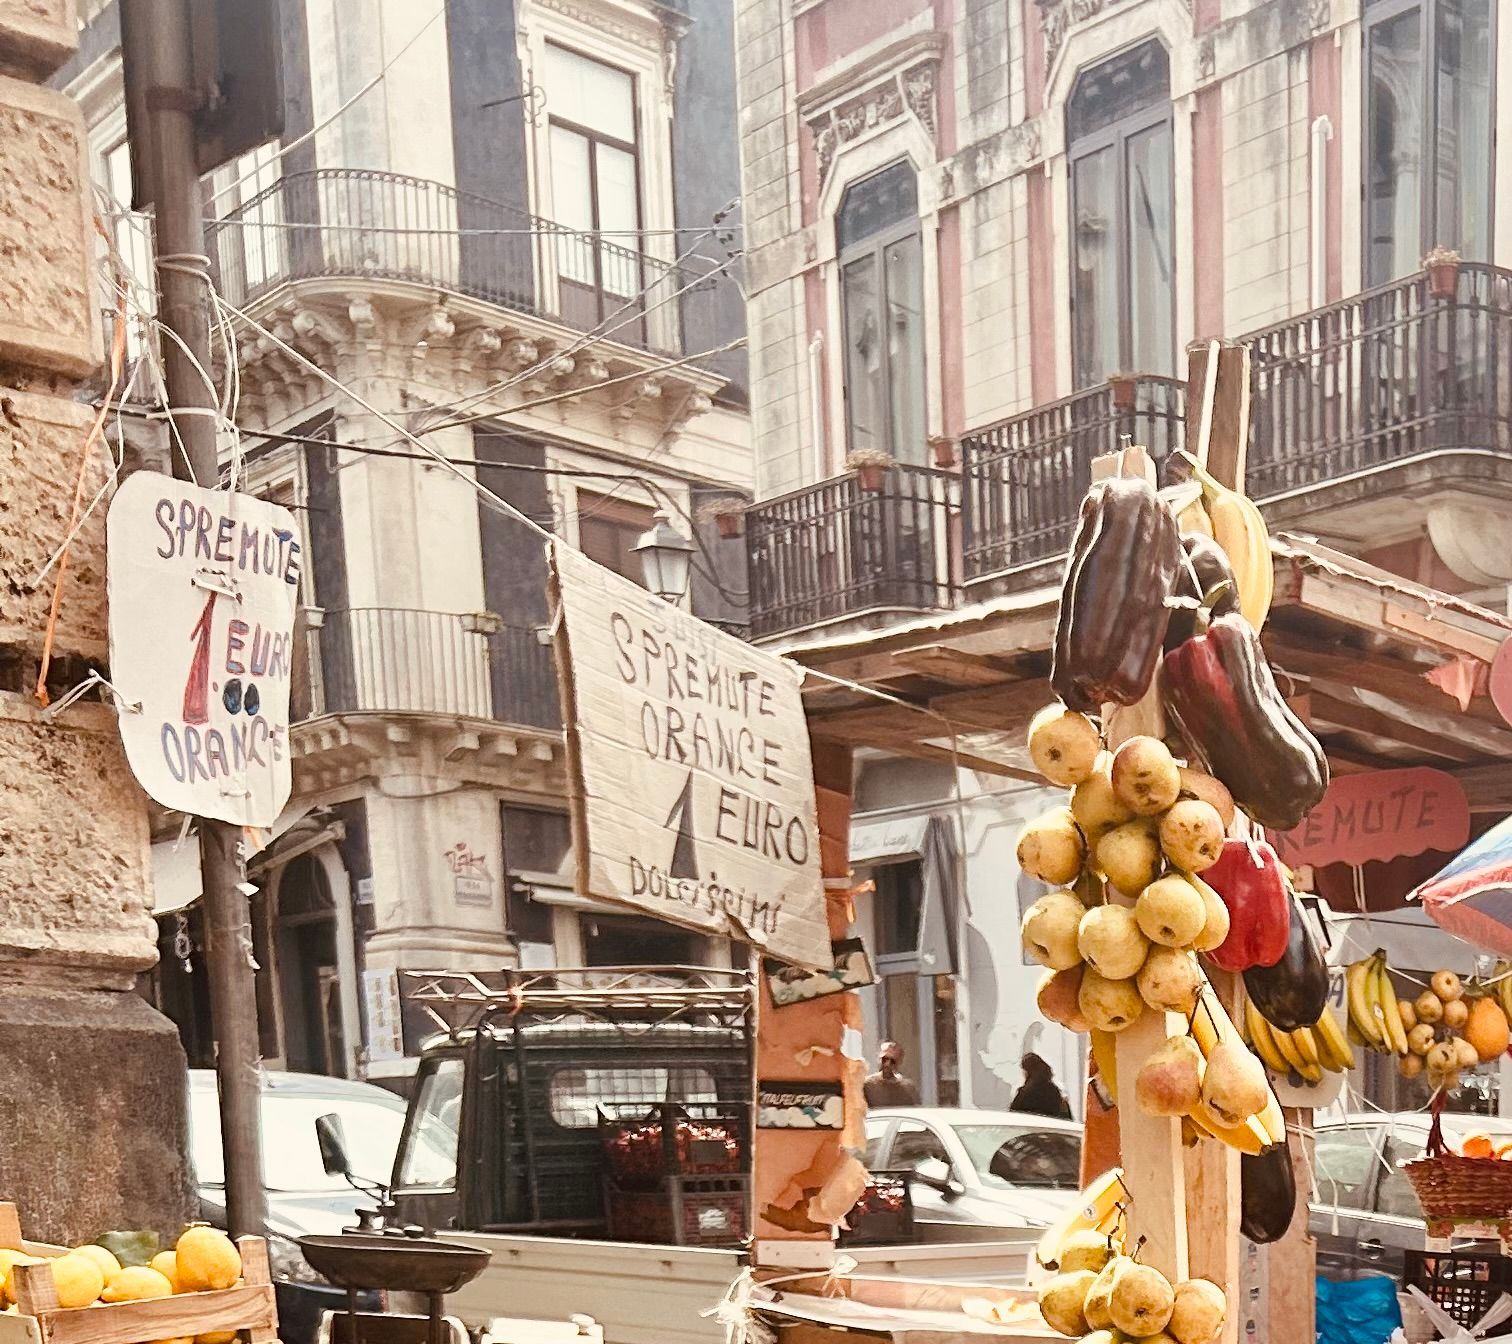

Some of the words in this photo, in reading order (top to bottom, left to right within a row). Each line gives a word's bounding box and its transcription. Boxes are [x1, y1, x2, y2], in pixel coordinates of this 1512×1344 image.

[156, 498, 300, 584] SPREMUTE
[225, 619, 290, 681] EURO
[611, 612, 776, 717] SPREMUTE
[664, 767, 699, 880] 1
[716, 787, 808, 866] EURO
